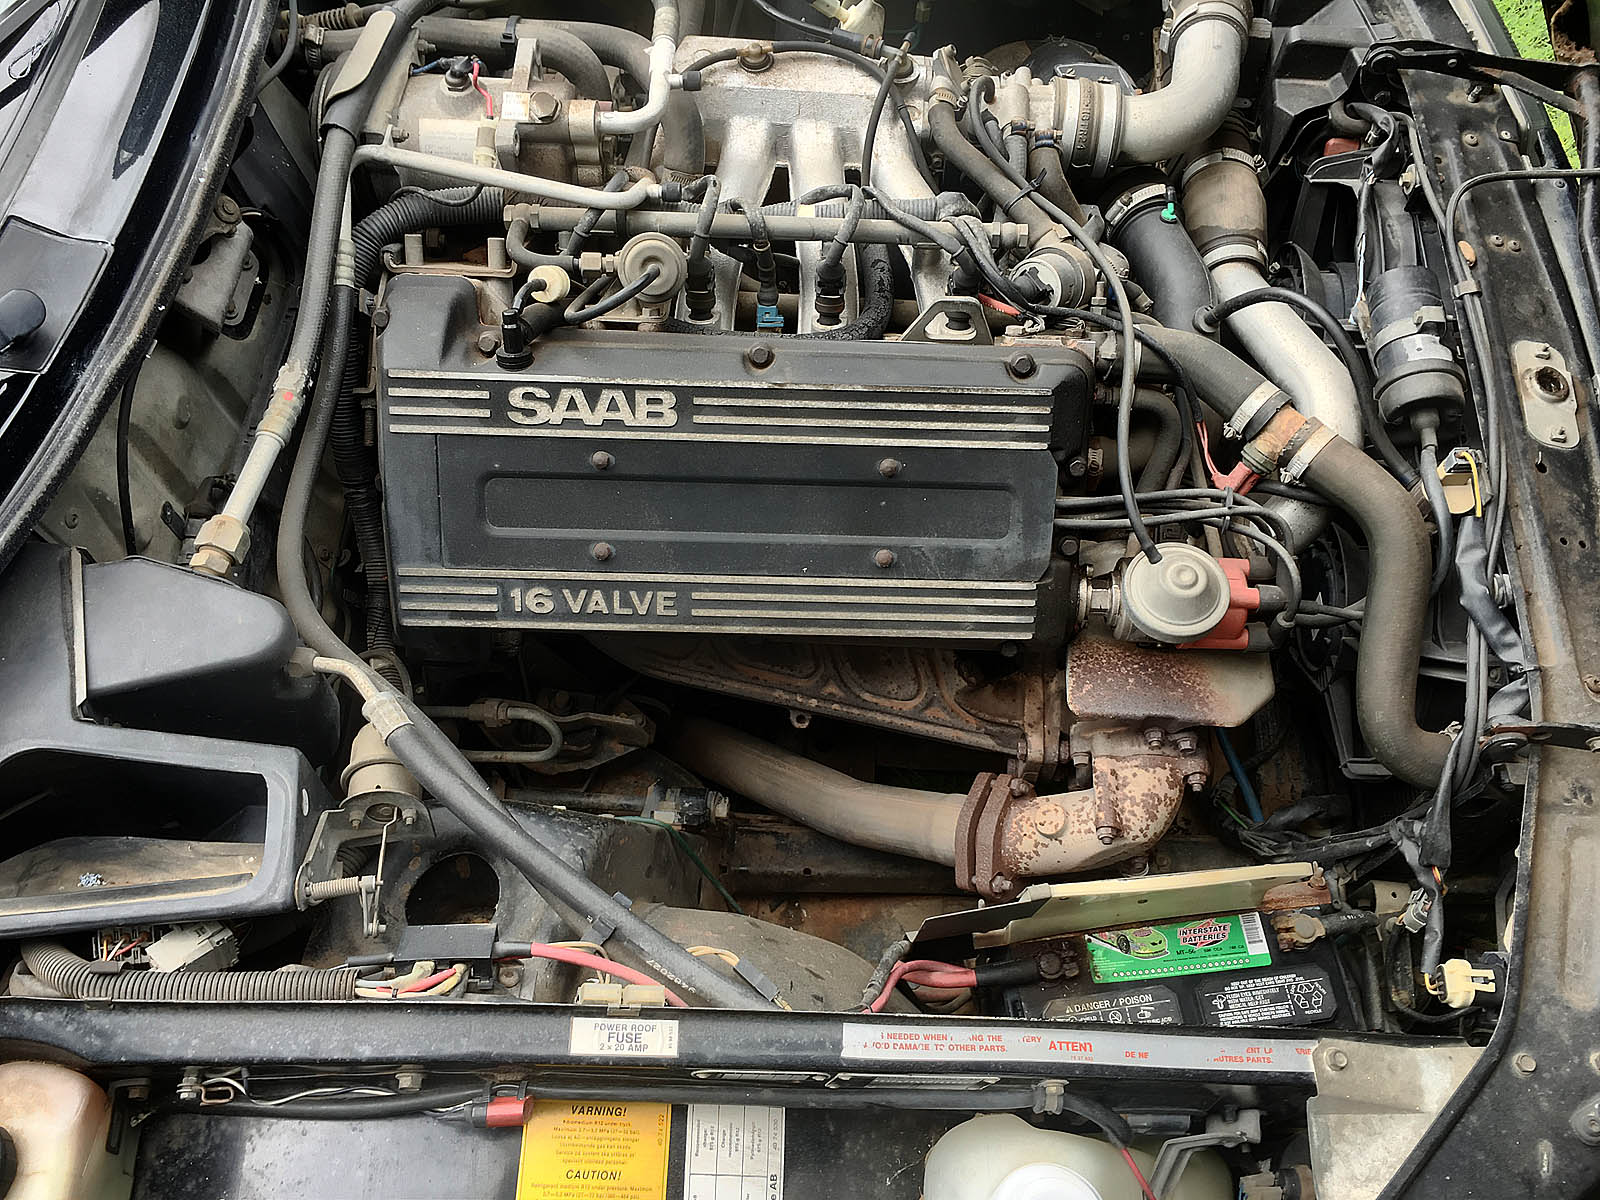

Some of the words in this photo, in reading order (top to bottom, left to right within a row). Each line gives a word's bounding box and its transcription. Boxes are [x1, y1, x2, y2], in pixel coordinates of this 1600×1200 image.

[506, 386, 678, 427] SAAB
[510, 587, 555, 613] 16
[562, 588, 678, 616] VALVE
[1179, 925, 1228, 936] INTERSTATE
[1182, 932, 1226, 943] BATTERIES
[1074, 1000, 1111, 1013] DANGER
[1118, 993, 1153, 1006] POISON
[593, 1022, 628, 1032] POWER
[630, 1023, 657, 1033] ROOF
[607, 1031, 642, 1044] FUSE
[886, 1032, 920, 1041] NEEDED
[922, 1033, 948, 1041] WHEN
[986, 1034, 1003, 1042] THE
[599, 1043, 605, 1051] 2
[614, 1043, 625, 1051] 20
[627, 1043, 649, 1052] AMP
[947, 1043, 977, 1052] OTHER
[571, 1105, 627, 1117] VARNING!
[565, 1169, 622, 1181] CAUTION!
[769, 1173, 778, 1191] AB
